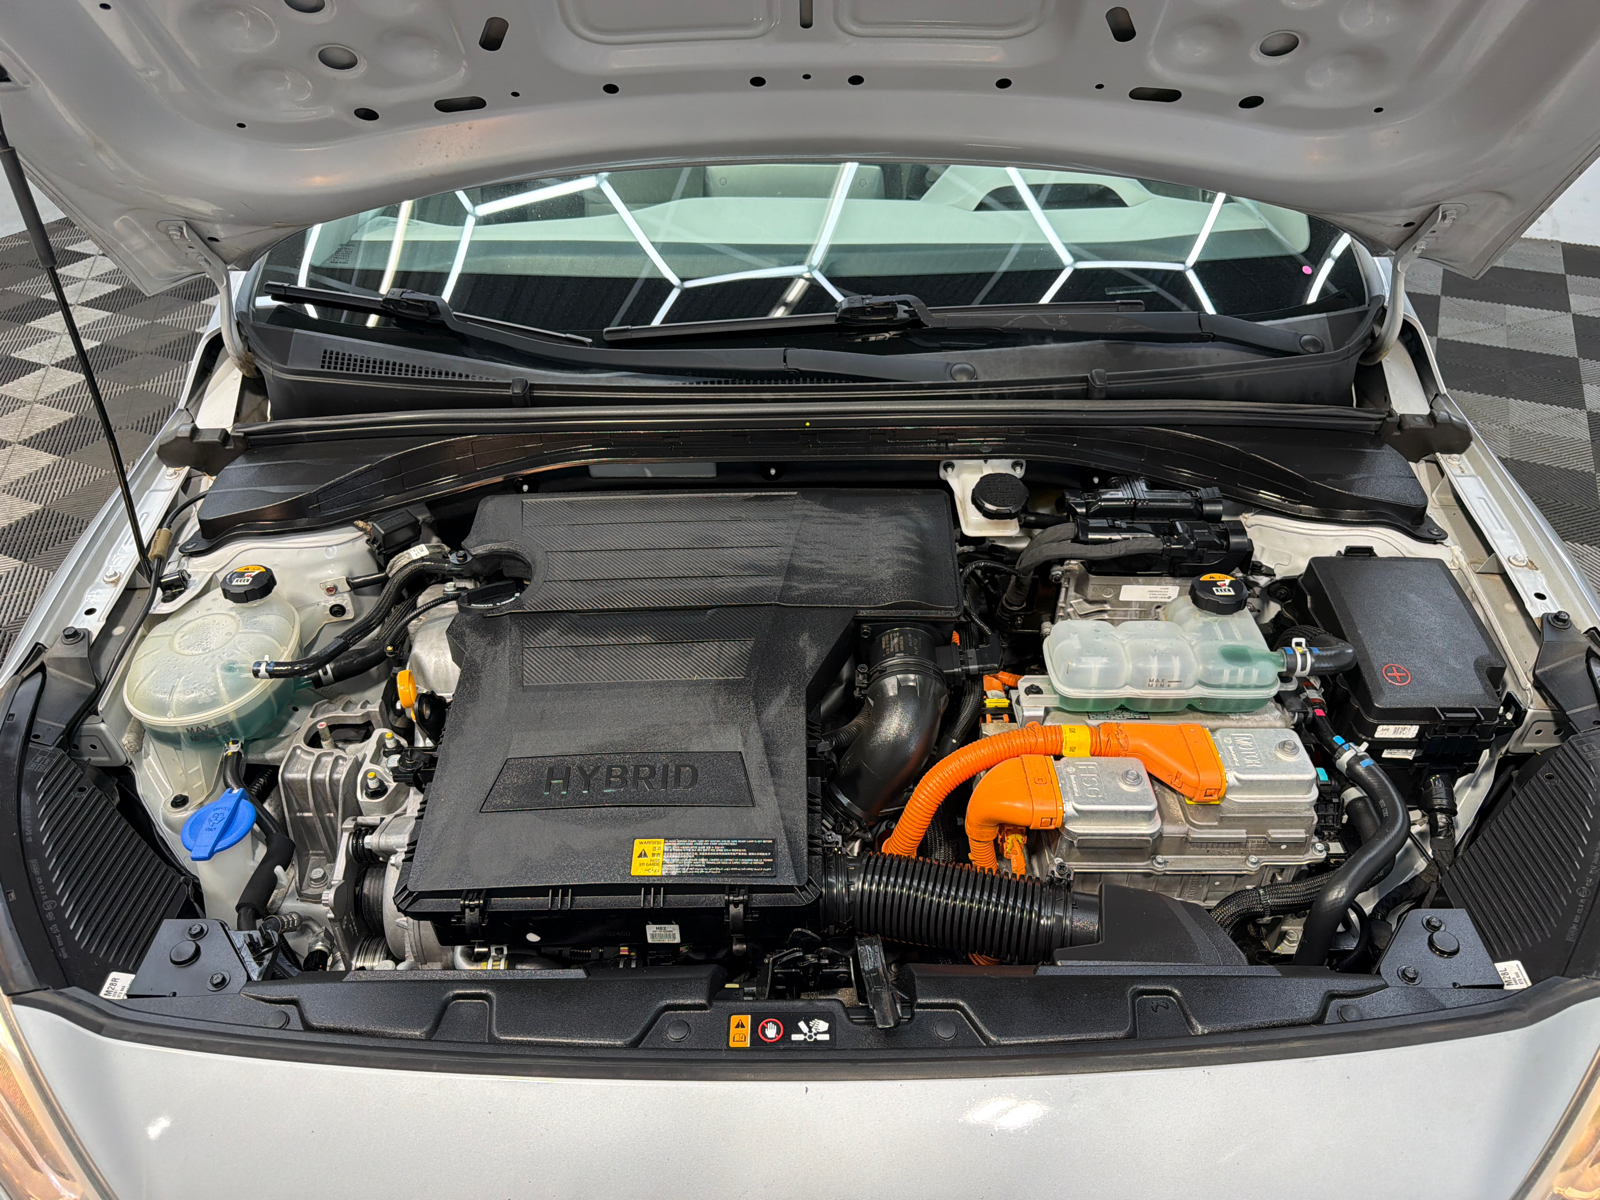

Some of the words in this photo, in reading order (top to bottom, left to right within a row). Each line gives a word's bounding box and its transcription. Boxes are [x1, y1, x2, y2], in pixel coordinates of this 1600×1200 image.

[185, 723, 211, 733] MAX
[1234, 735, 1263, 767] MOTOR
[543, 763, 699, 795] HYBRID
